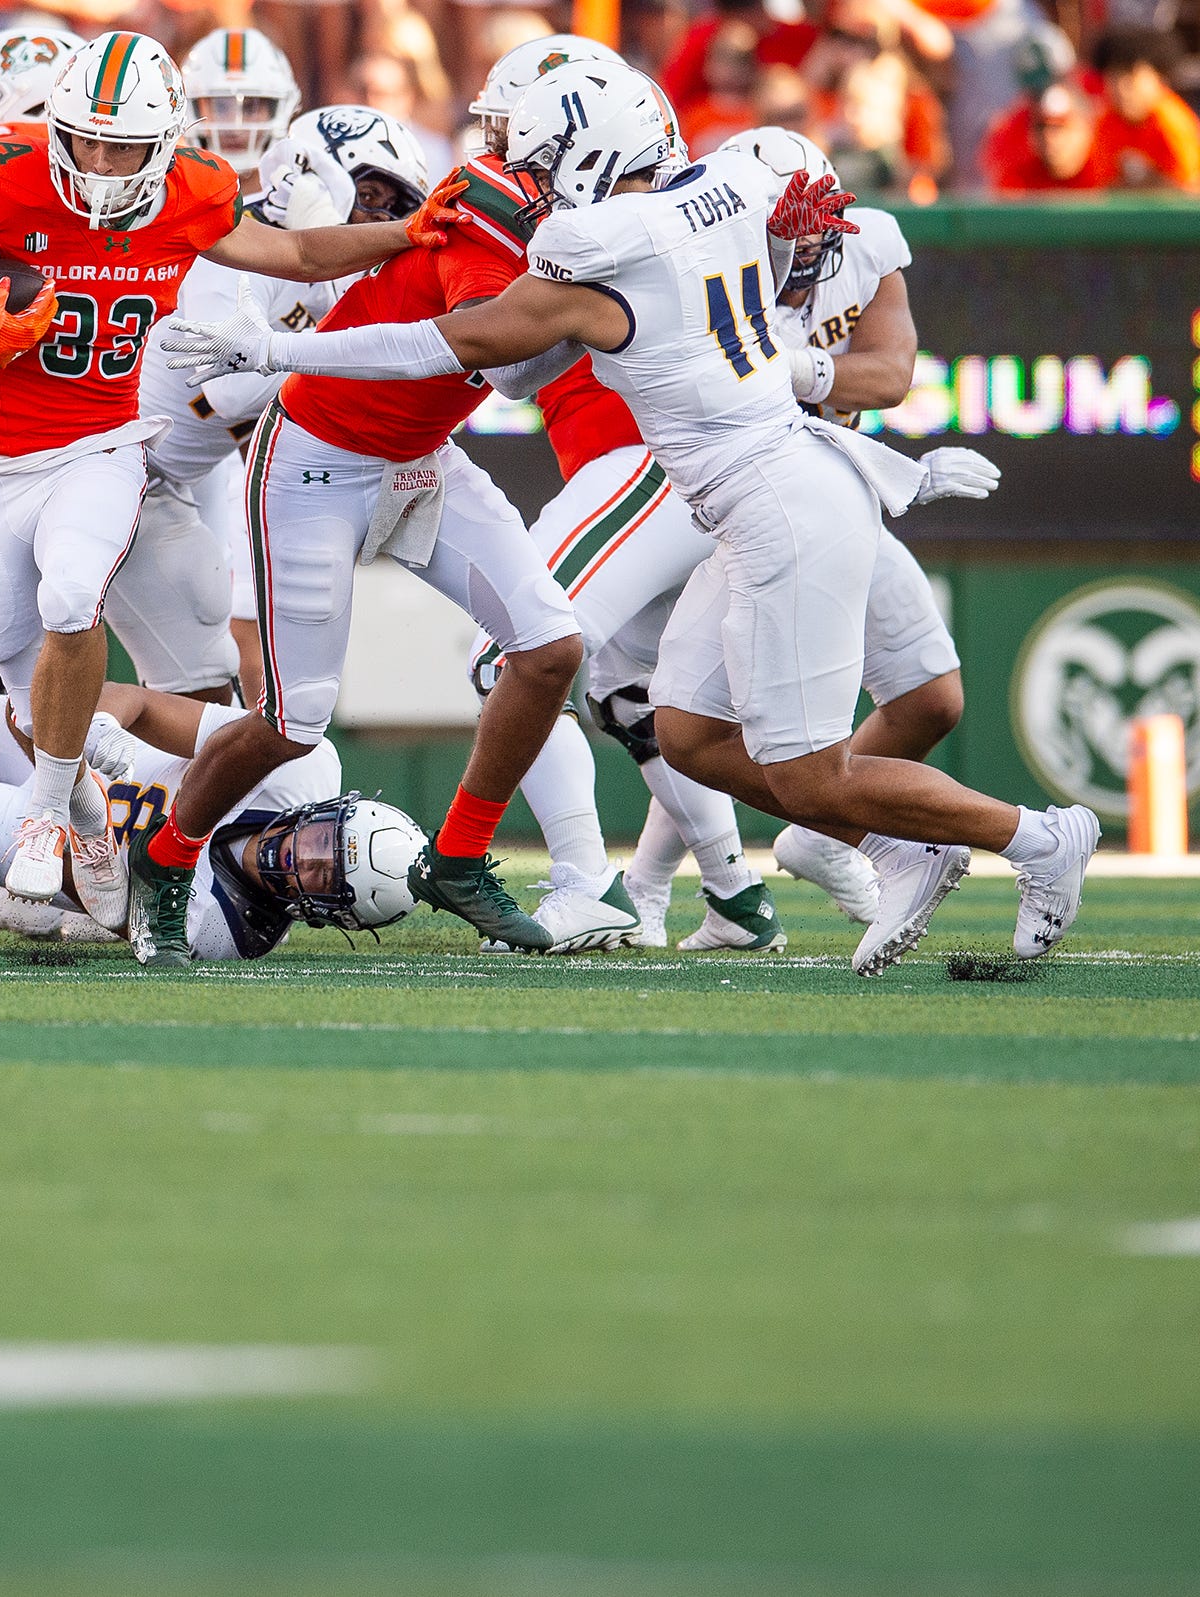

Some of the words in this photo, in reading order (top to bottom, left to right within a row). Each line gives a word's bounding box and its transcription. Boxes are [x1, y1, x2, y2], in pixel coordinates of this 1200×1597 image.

[561, 90, 589, 133] 11
[675, 182, 748, 233] TUHA
[143, 264, 180, 282] A&M
[535, 255, 574, 283] UNC
[38, 291, 158, 380] 33
[703, 259, 779, 383] 11
[860, 350, 1181, 440] SIUM.
[392, 479, 439, 492] HOLLOWAY
[394, 469, 437, 482] TREVAUN
